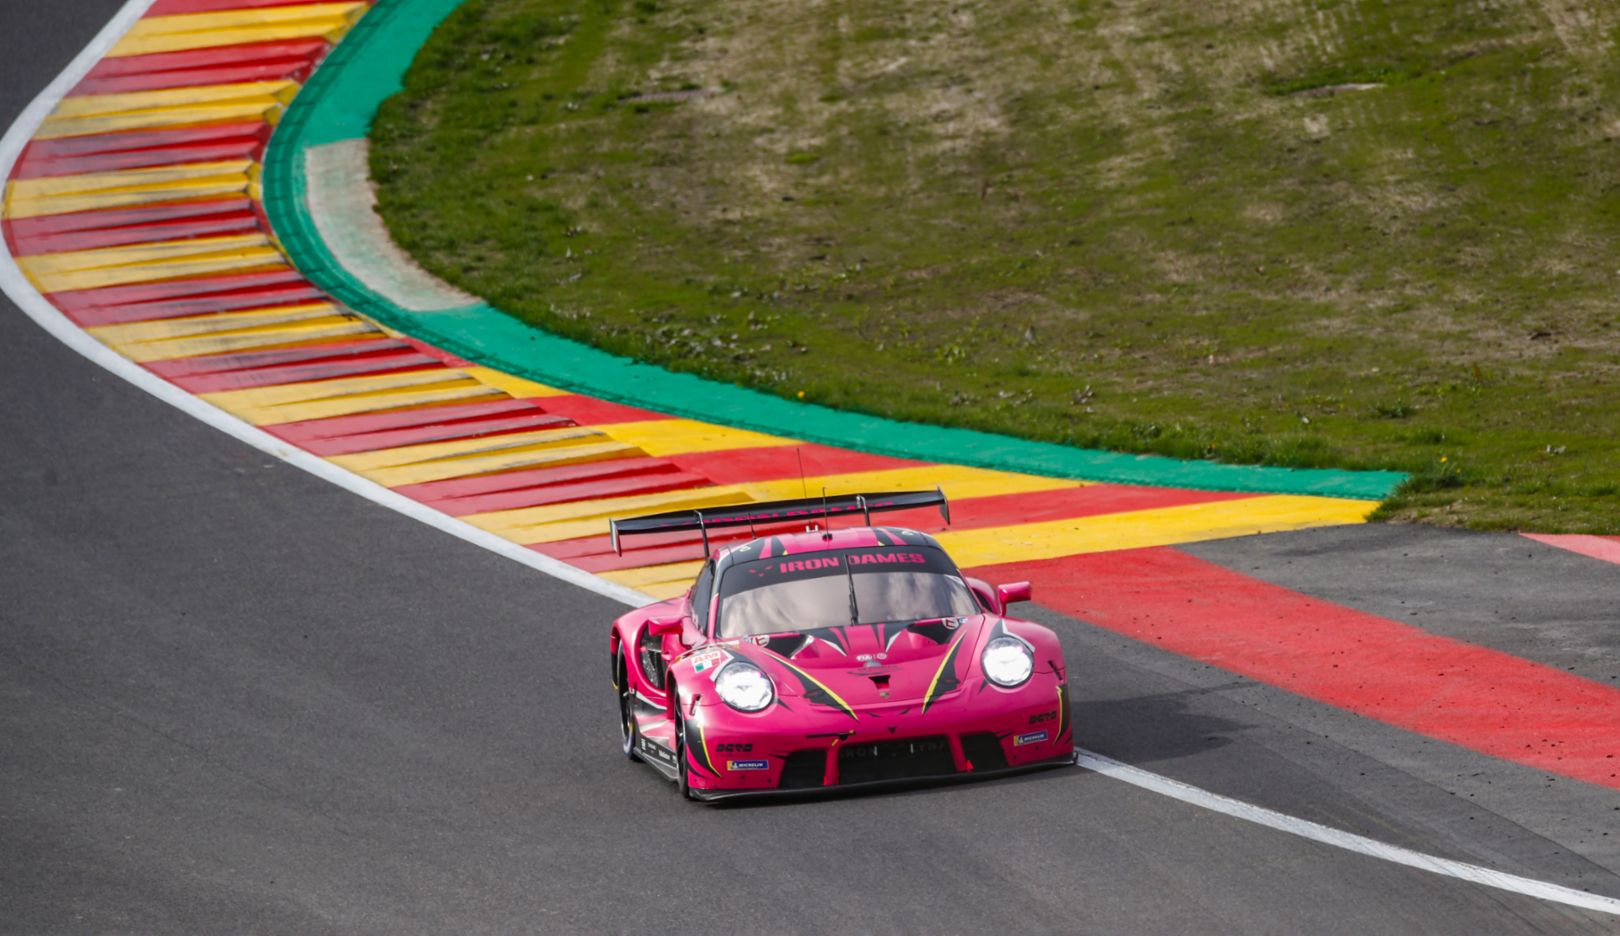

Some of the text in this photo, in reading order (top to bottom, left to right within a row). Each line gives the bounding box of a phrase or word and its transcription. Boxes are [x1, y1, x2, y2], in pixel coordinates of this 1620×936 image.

[779, 552, 926, 574] IRON DAMES
[694, 652, 719, 664] AM
